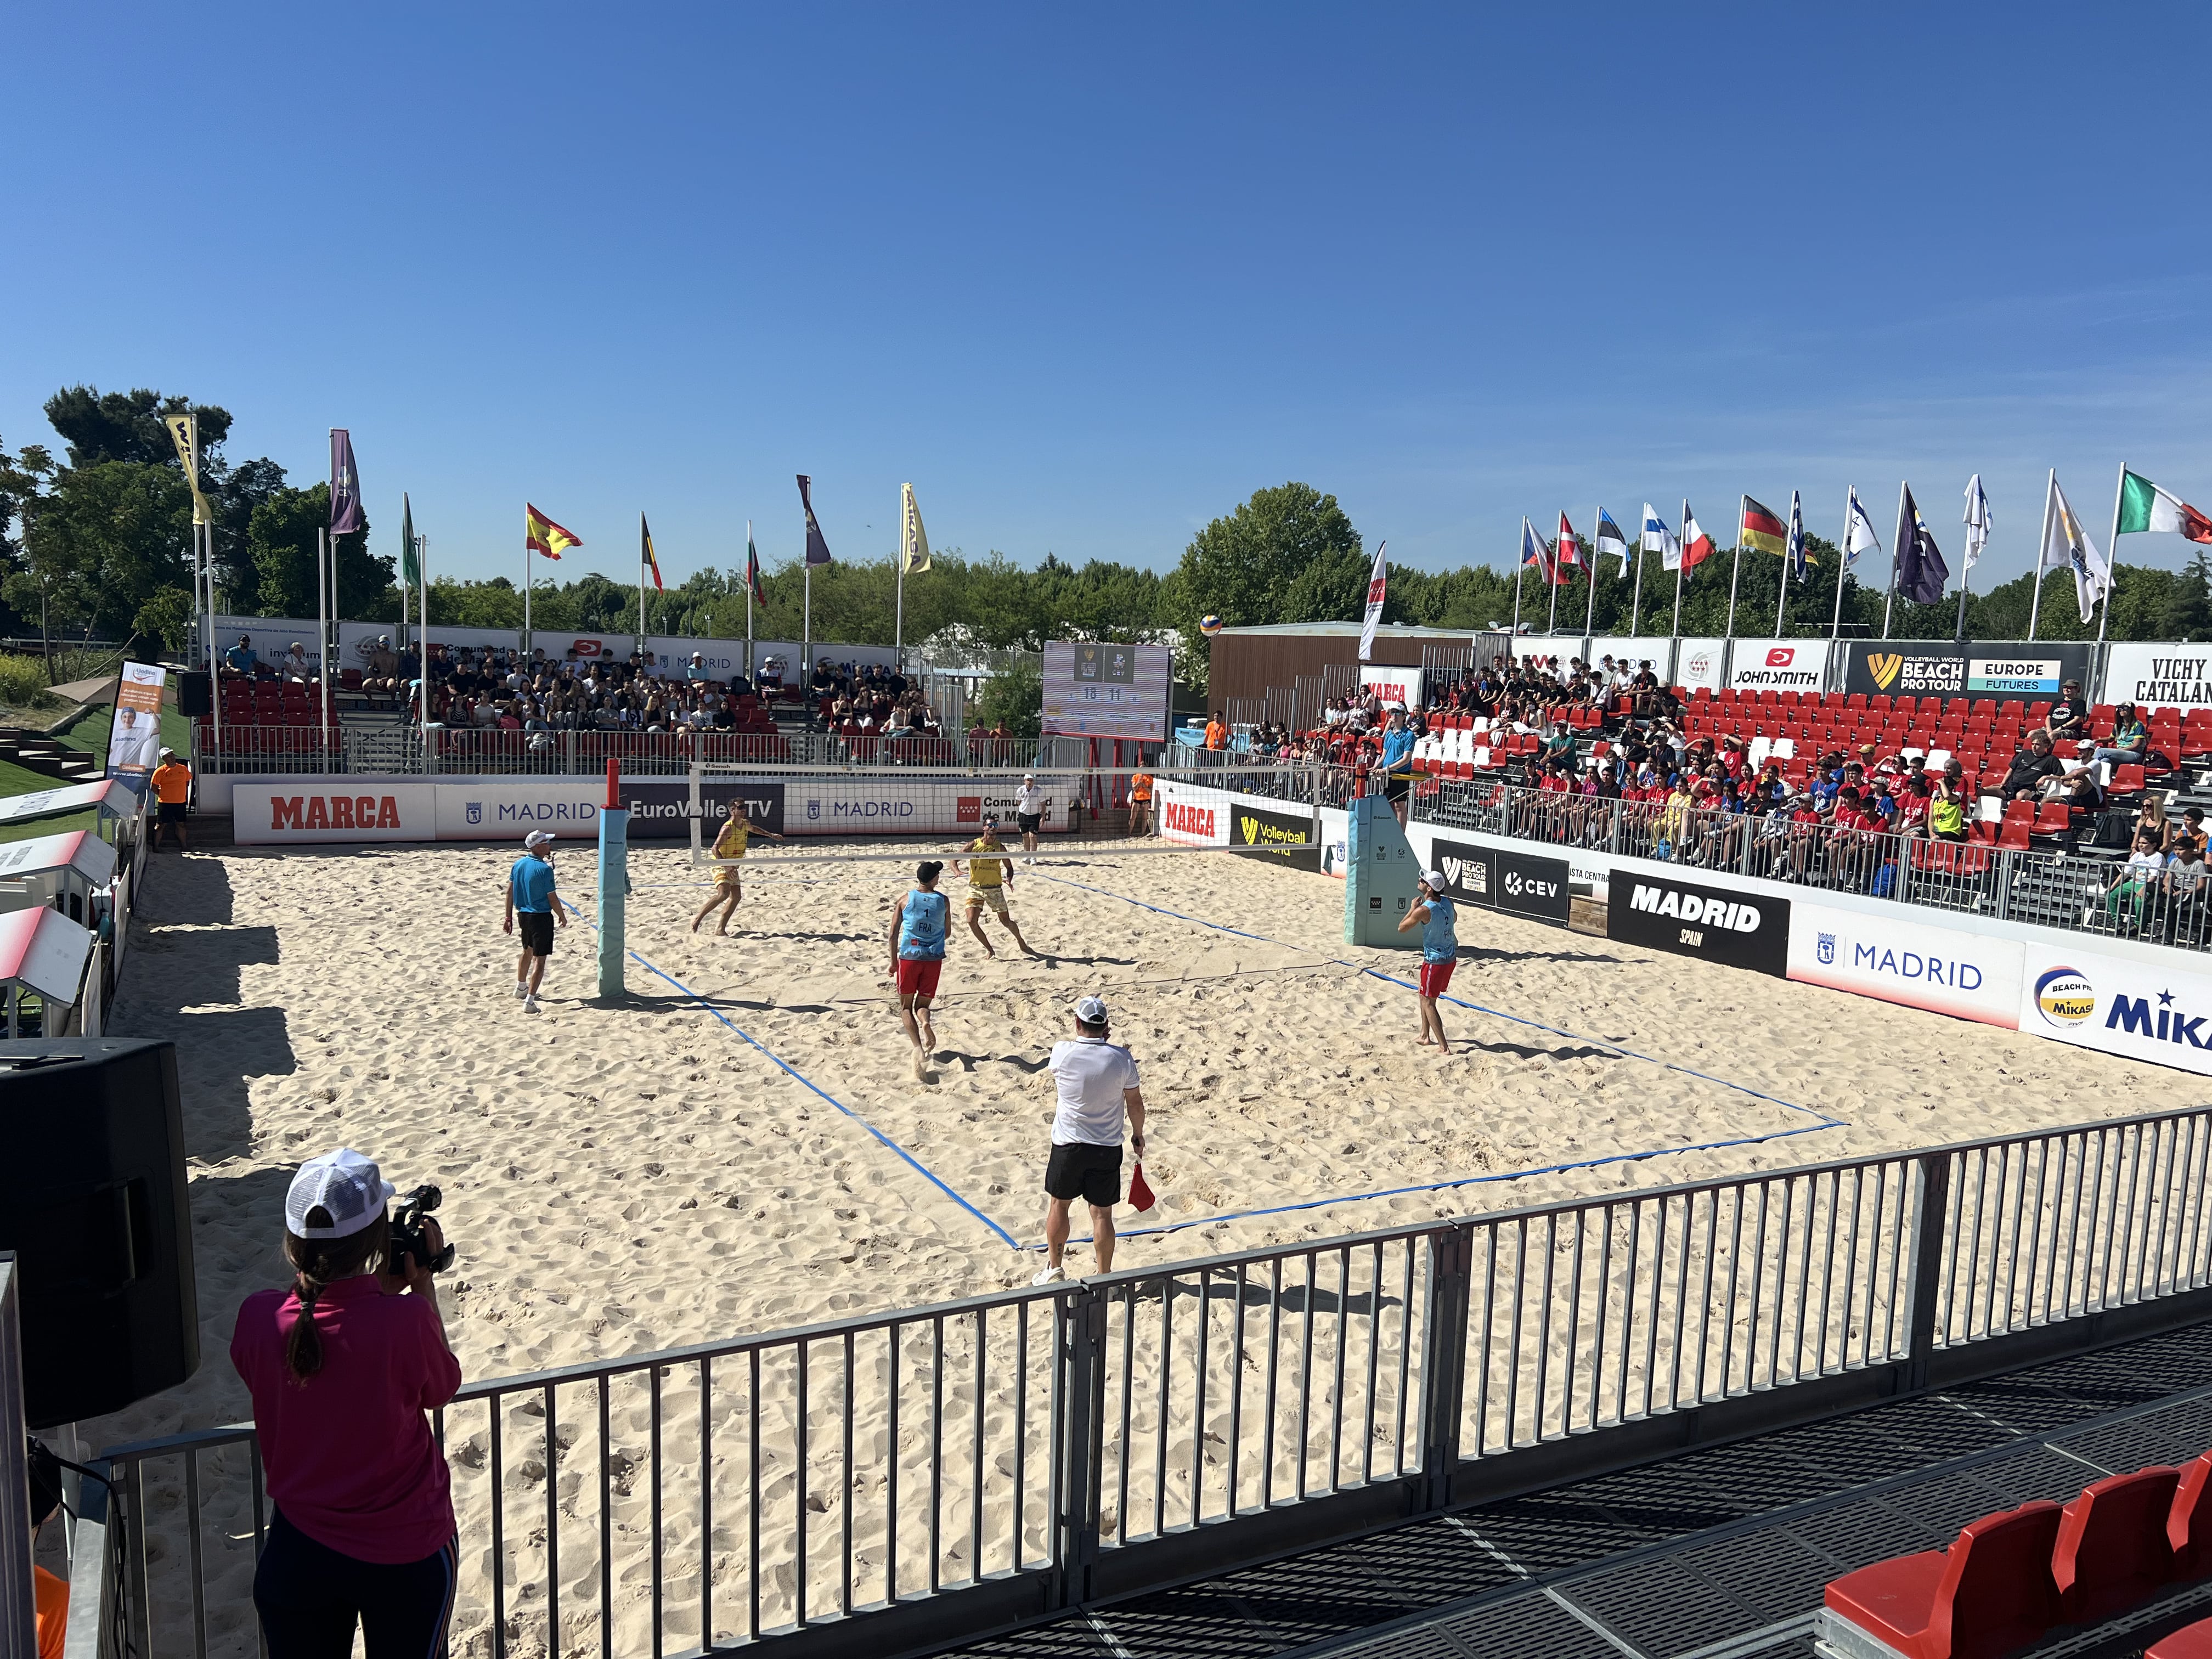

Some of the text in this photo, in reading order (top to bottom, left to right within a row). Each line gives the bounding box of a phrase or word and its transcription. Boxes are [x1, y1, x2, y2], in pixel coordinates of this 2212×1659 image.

[807, 524, 817, 534] EV
[136, 668, 155, 676] Aladina
[840, 662, 891, 675] MIKAA
[1901, 662, 1963, 679] BEACH
[1985, 663, 2044, 675] EUROPE
[2152, 658, 2207, 680] VICHY
[1735, 670, 1818, 685] JOHN SMITH
[1900, 679, 1961, 691] PRO TOUR
[1986, 680, 2039, 690] FUTURES
[1085, 687, 1097, 699] 18
[1109, 689, 1120, 701] 11
[270, 796, 401, 830] MARCA
[498, 803, 596, 821] MADRID
[744, 800, 772, 817] TV
[834, 802, 913, 817] MADRID
[1166, 802, 1215, 838] MARCA
[1260, 823, 1306, 844] Volleyball
[1462, 862, 1486, 875] BEACH
[1569, 868, 1610, 884] ISTA CENTRA
[1472, 872, 1486, 881] TOUR
[1525, 878, 1558, 898] CEV
[923, 908, 929, 918] 1
[1629, 884, 1761, 933] MADRID
[918, 922, 932, 933] FRA
[1679, 928, 1703, 947] SPAIN
[1854, 942, 1982, 990] MADRID
[2052, 984, 2081, 992] BEACH
[2105, 991, 2212, 1051] MIK
